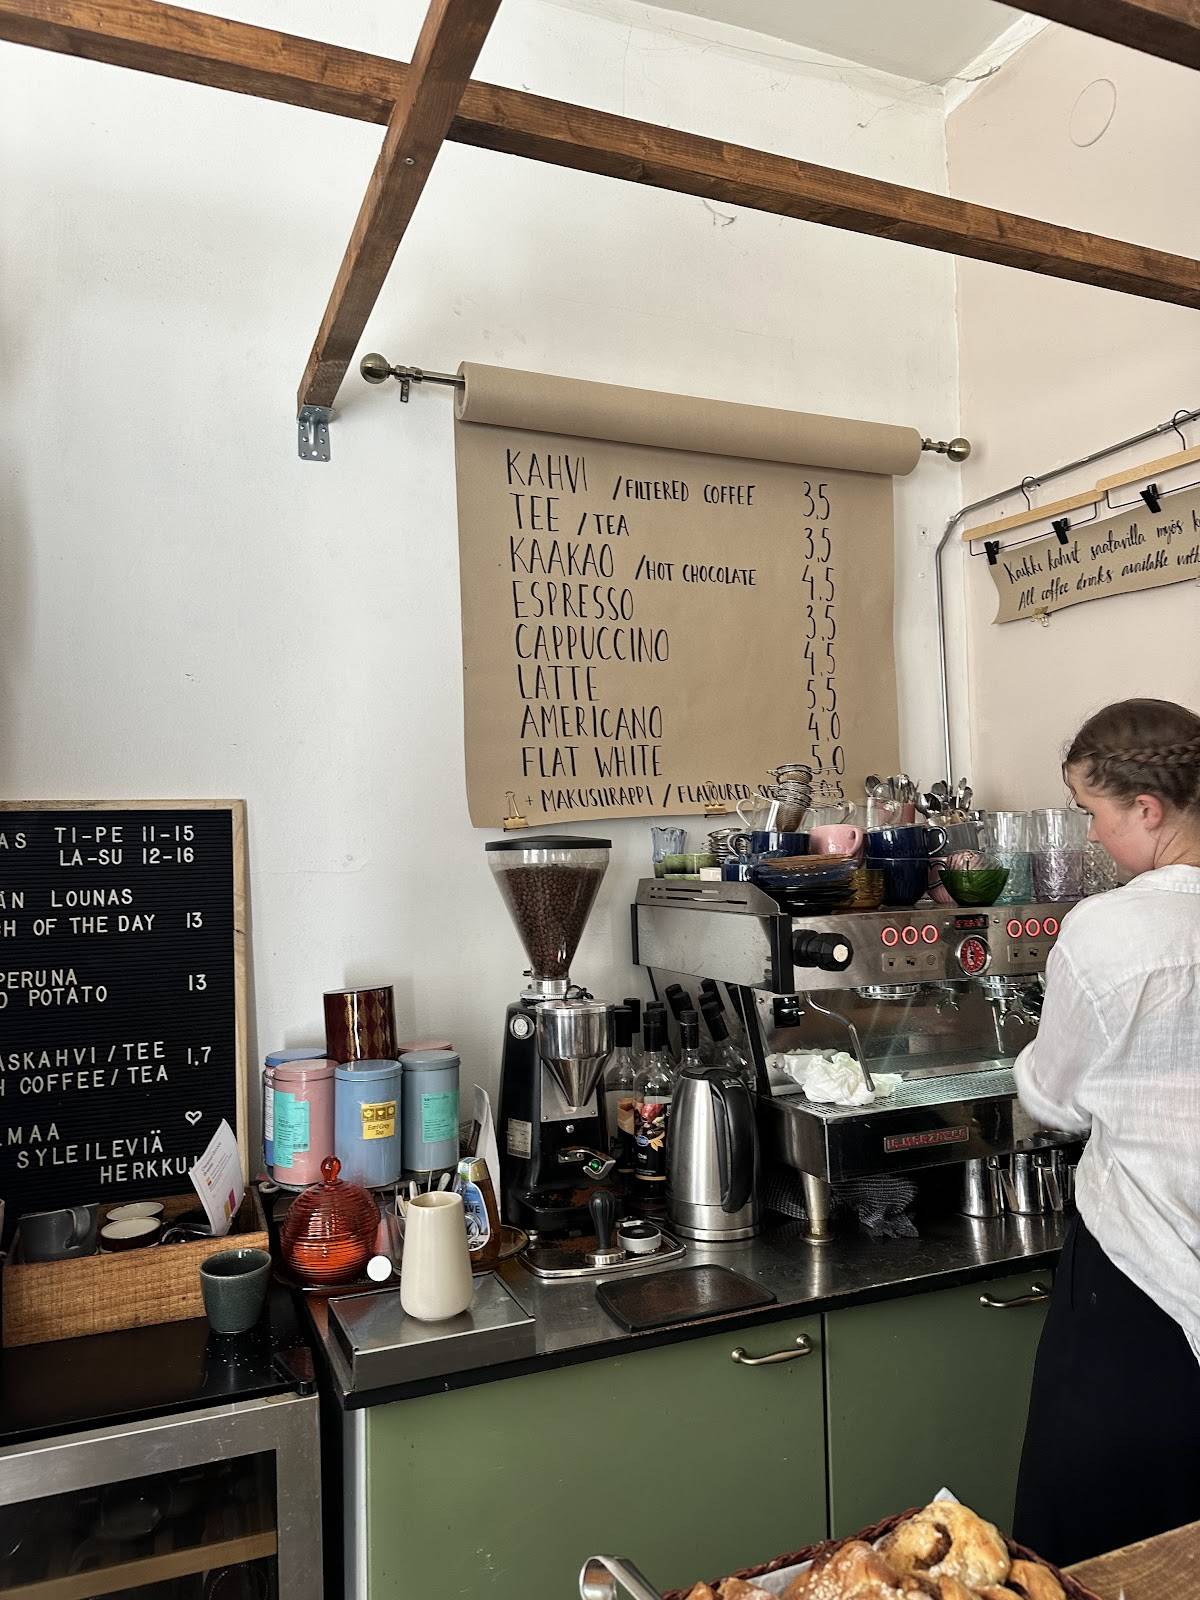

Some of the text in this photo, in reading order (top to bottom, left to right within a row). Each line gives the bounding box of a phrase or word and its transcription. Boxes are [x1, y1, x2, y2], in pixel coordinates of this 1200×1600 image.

[504, 446, 590, 496] KAHVI
[702, 482, 758, 507] COFFEE
[508, 492, 562, 533] TEE
[508, 535, 616, 580] KAAKAO
[681, 563, 758, 587] CHOCOLATE
[1003, 554, 1043, 585] Kaikki
[1047, 541, 1081, 572] kahvit
[511, 579, 635, 622] ESPRESSO
[1017, 586, 1036, 612] All
[1041, 577, 1070, 602] coffee
[1076, 565, 1113, 591] drinks
[514, 622, 671, 664] CAPPUCCINO
[516, 662, 601, 702] LATTE
[519, 703, 664, 741] AMERICANO
[520, 743, 580, 779] FLAT
[593, 742, 664, 780] WHITE
[540, 783, 655, 813] MAKUSIIRAPPI
[677, 783, 750, 804] FLAVOURED
[53, 825, 125, 845] TI-PE
[141, 824, 196, 843] 11-15
[58, 846, 196, 867] LA-SU 12-16
[50, 887, 134, 909] LOUNAS
[31, 917, 58, 937] OF
[68, 915, 110, 935] THE
[117, 913, 157, 933] DAY
[185, 911, 204, 930] 13
[27, 985, 109, 1008] POTATO
[187, 973, 208, 992] 13
[0, 1122, 61, 1147] MAA
[15, 1128, 165, 1170] SYLEILEVIÄ
